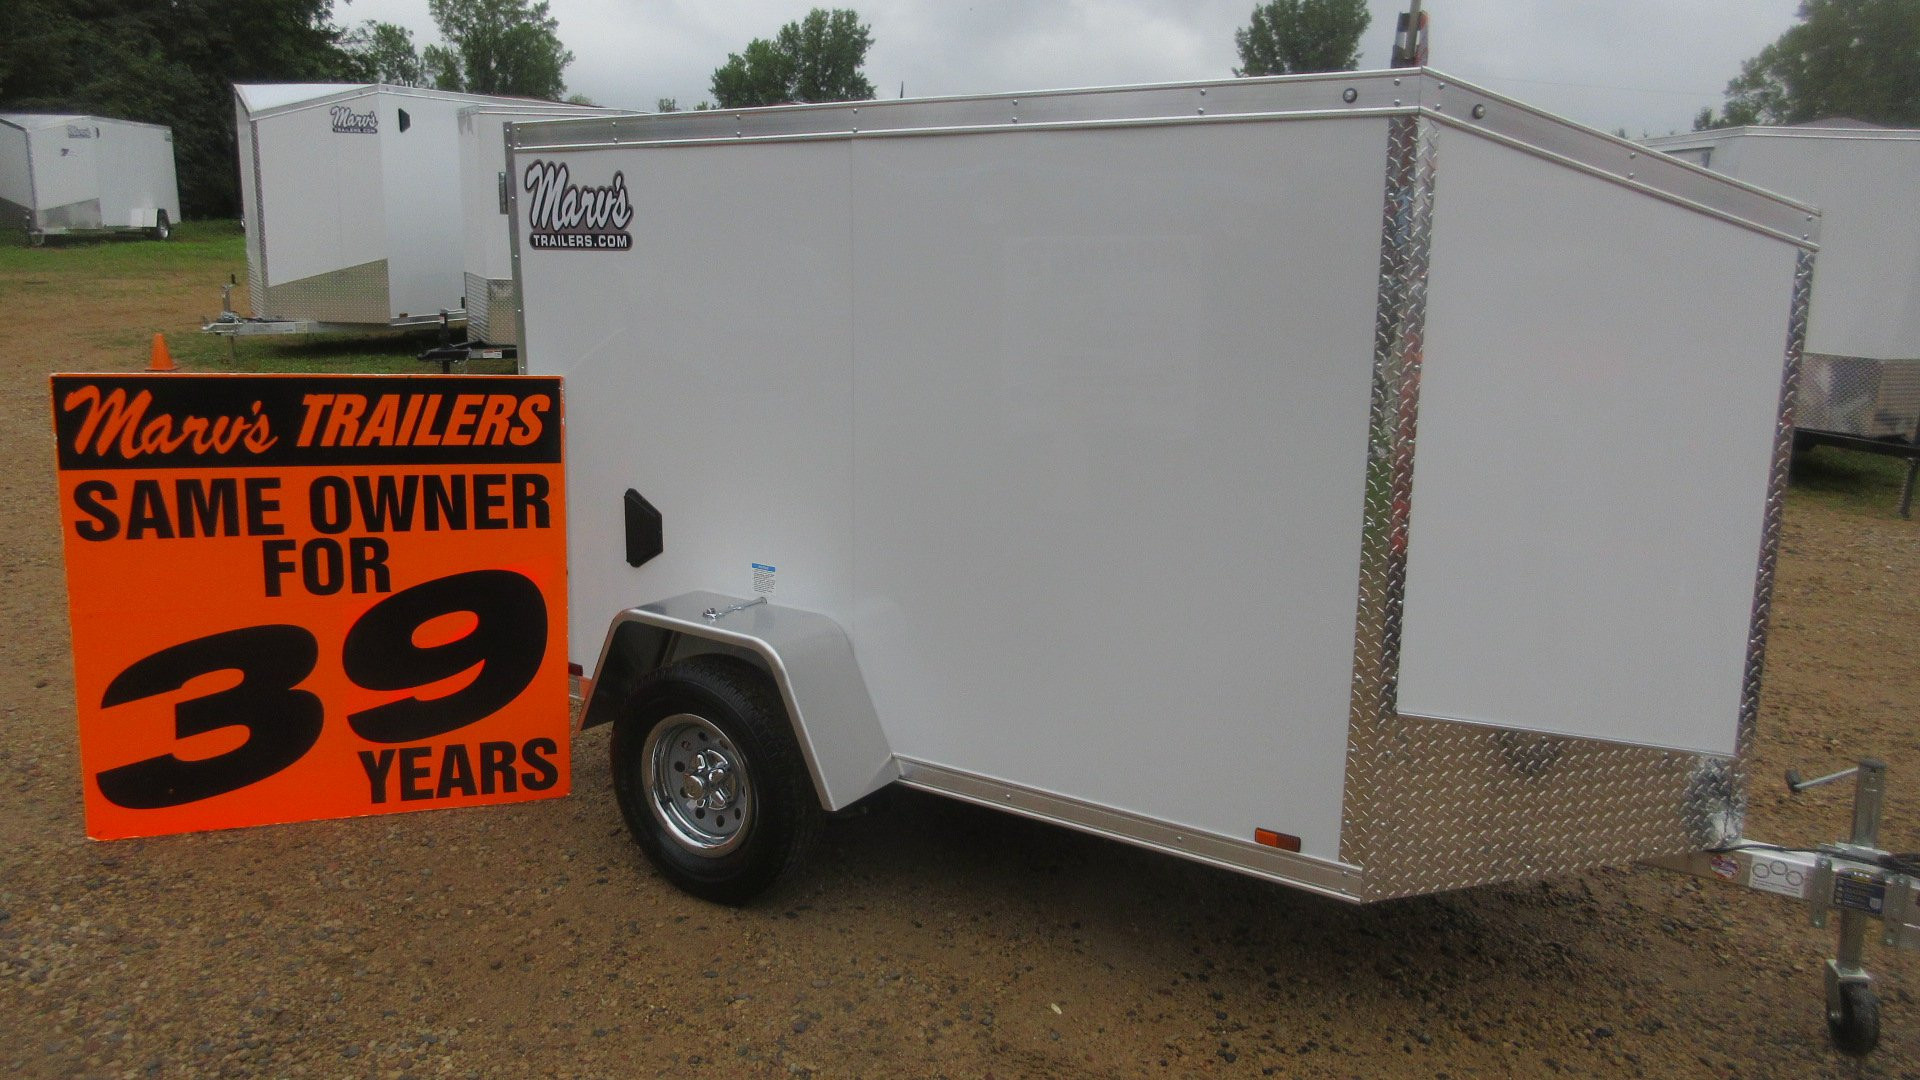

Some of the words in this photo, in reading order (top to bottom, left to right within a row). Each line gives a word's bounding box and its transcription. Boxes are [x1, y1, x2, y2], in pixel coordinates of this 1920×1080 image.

[331, 106, 378, 128] Marv's
[525, 160, 633, 231] Marv's
[533, 234, 628, 248] TRAILERS.COM
[63, 385, 279, 459] Marv's
[296, 393, 551, 448] TRAILERS
[73, 476, 285, 542] SAME
[308, 473, 551, 534] OWNER
[262, 537, 391, 597] FOR
[95, 569, 548, 810] 39
[357, 737, 559, 804] YEARS
